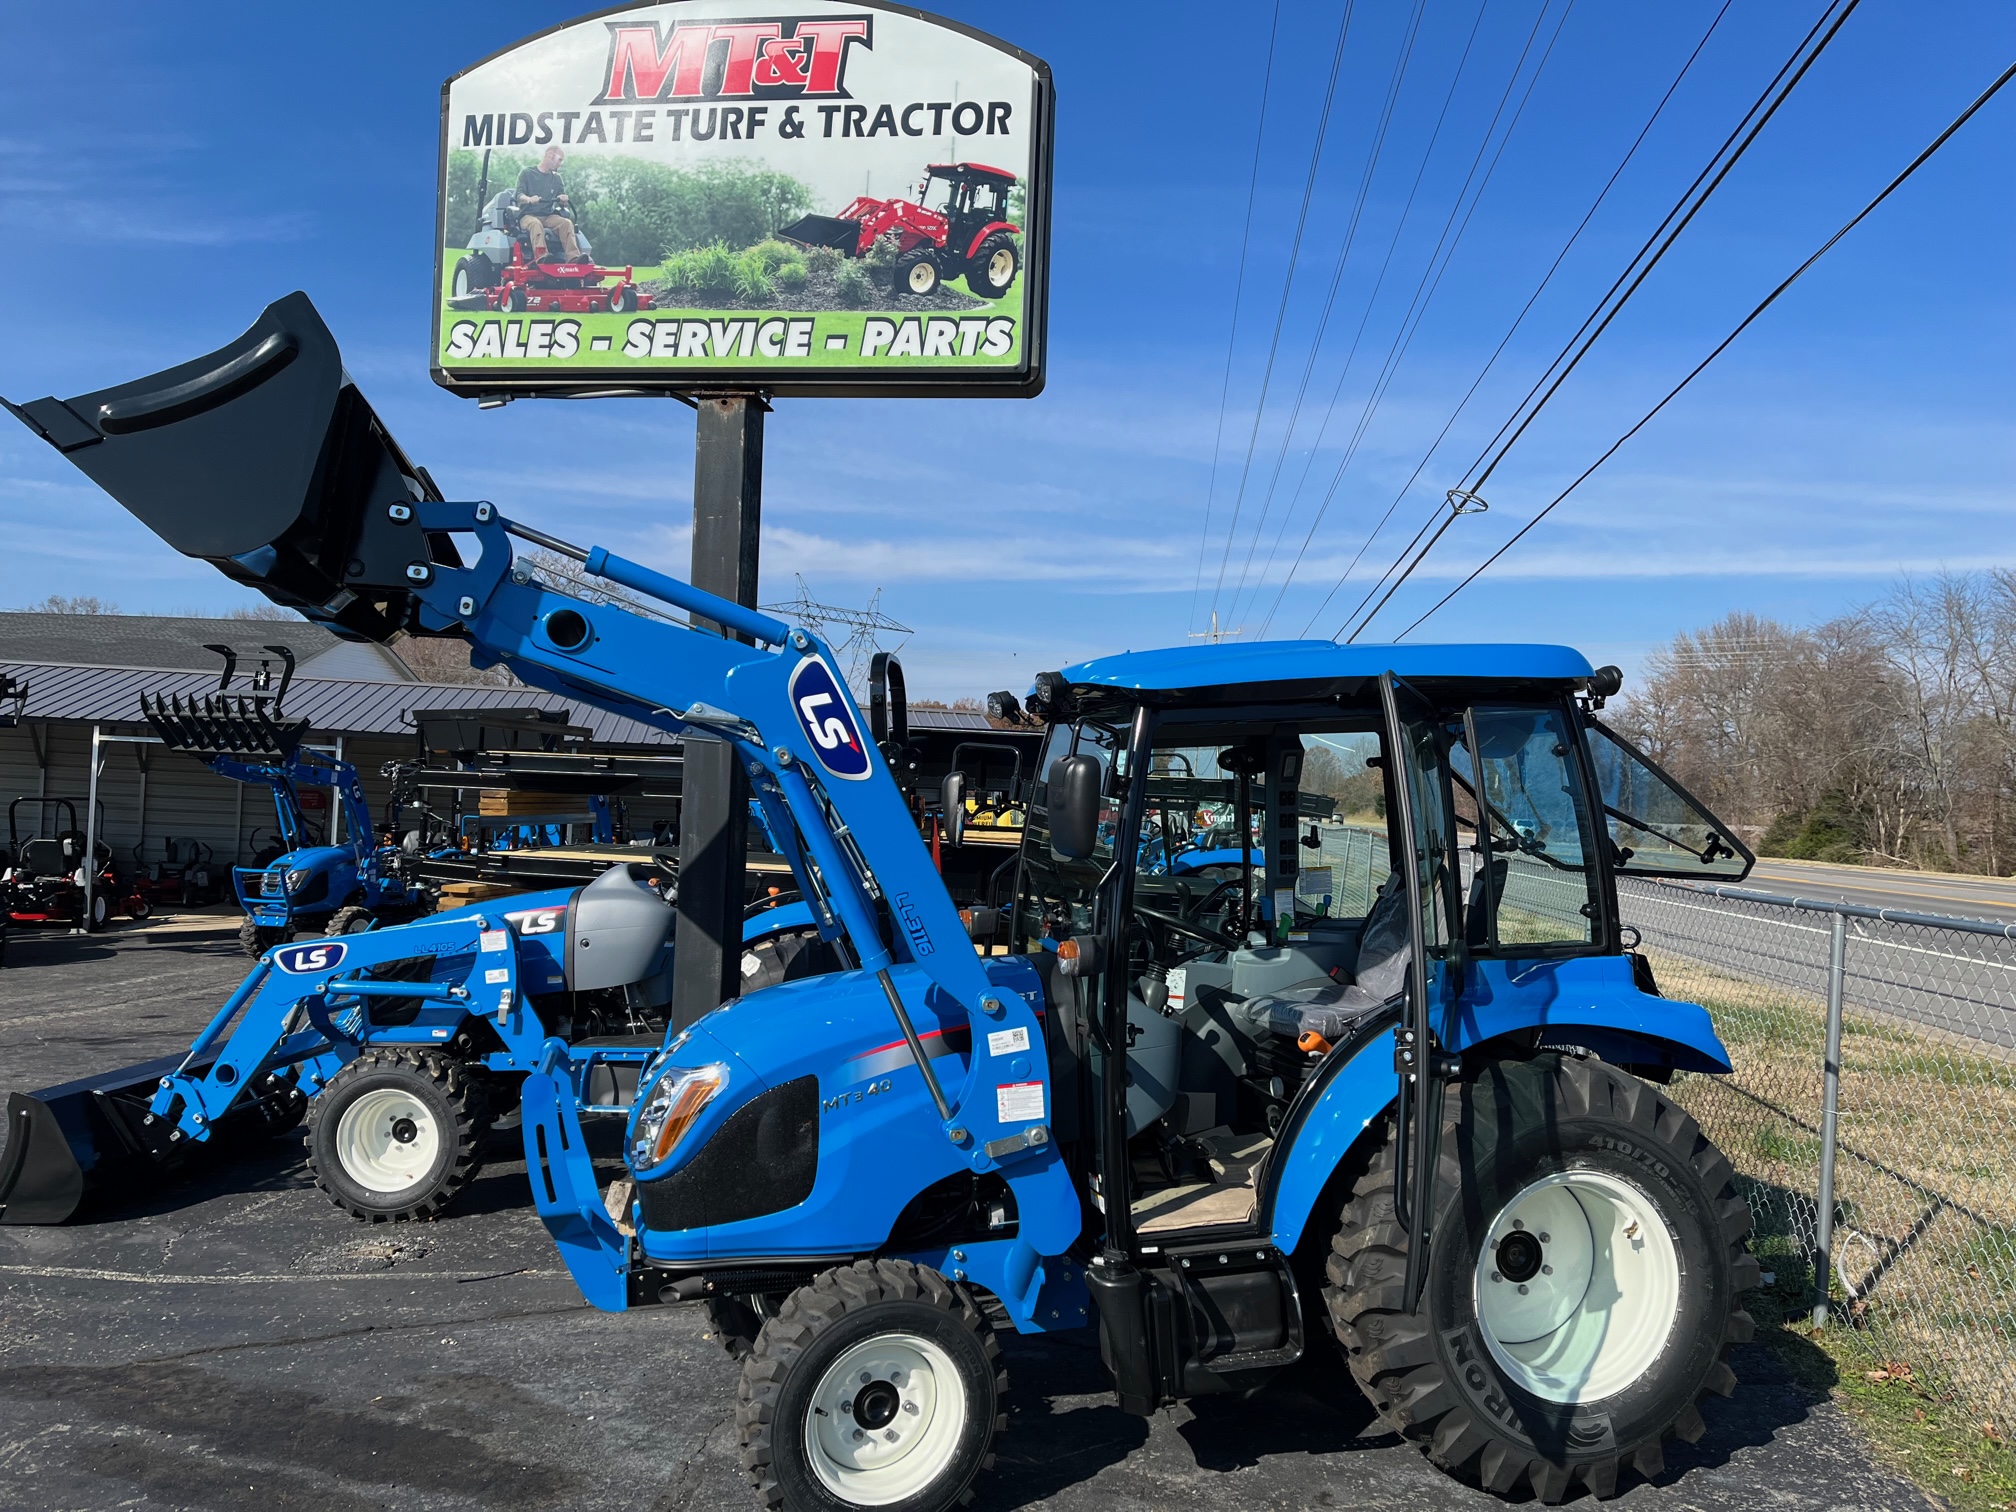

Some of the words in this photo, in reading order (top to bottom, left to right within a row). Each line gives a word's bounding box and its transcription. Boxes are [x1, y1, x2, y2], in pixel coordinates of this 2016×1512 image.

[602, 18, 872, 101] MT&T
[462, 109, 655, 148] MIDSTATE
[666, 105, 769, 142] TURF
[778, 105, 807, 140] &
[817, 100, 1014, 138] TRACTOR
[446, 317, 583, 360] SALES
[622, 316, 816, 359] SERVICE
[860, 315, 1017, 358] PARTS
[800, 692, 852, 750] LS
[520, 911, 557, 935] LS
[895, 892, 935, 957] LL3116
[294, 949, 328, 971] LS
[823, 1091, 864, 1115] MT3
[867, 1078, 893, 1097] 40
[1588, 1134, 1700, 1216] 410/70-20
[1448, 1332, 1527, 1438] IRON
